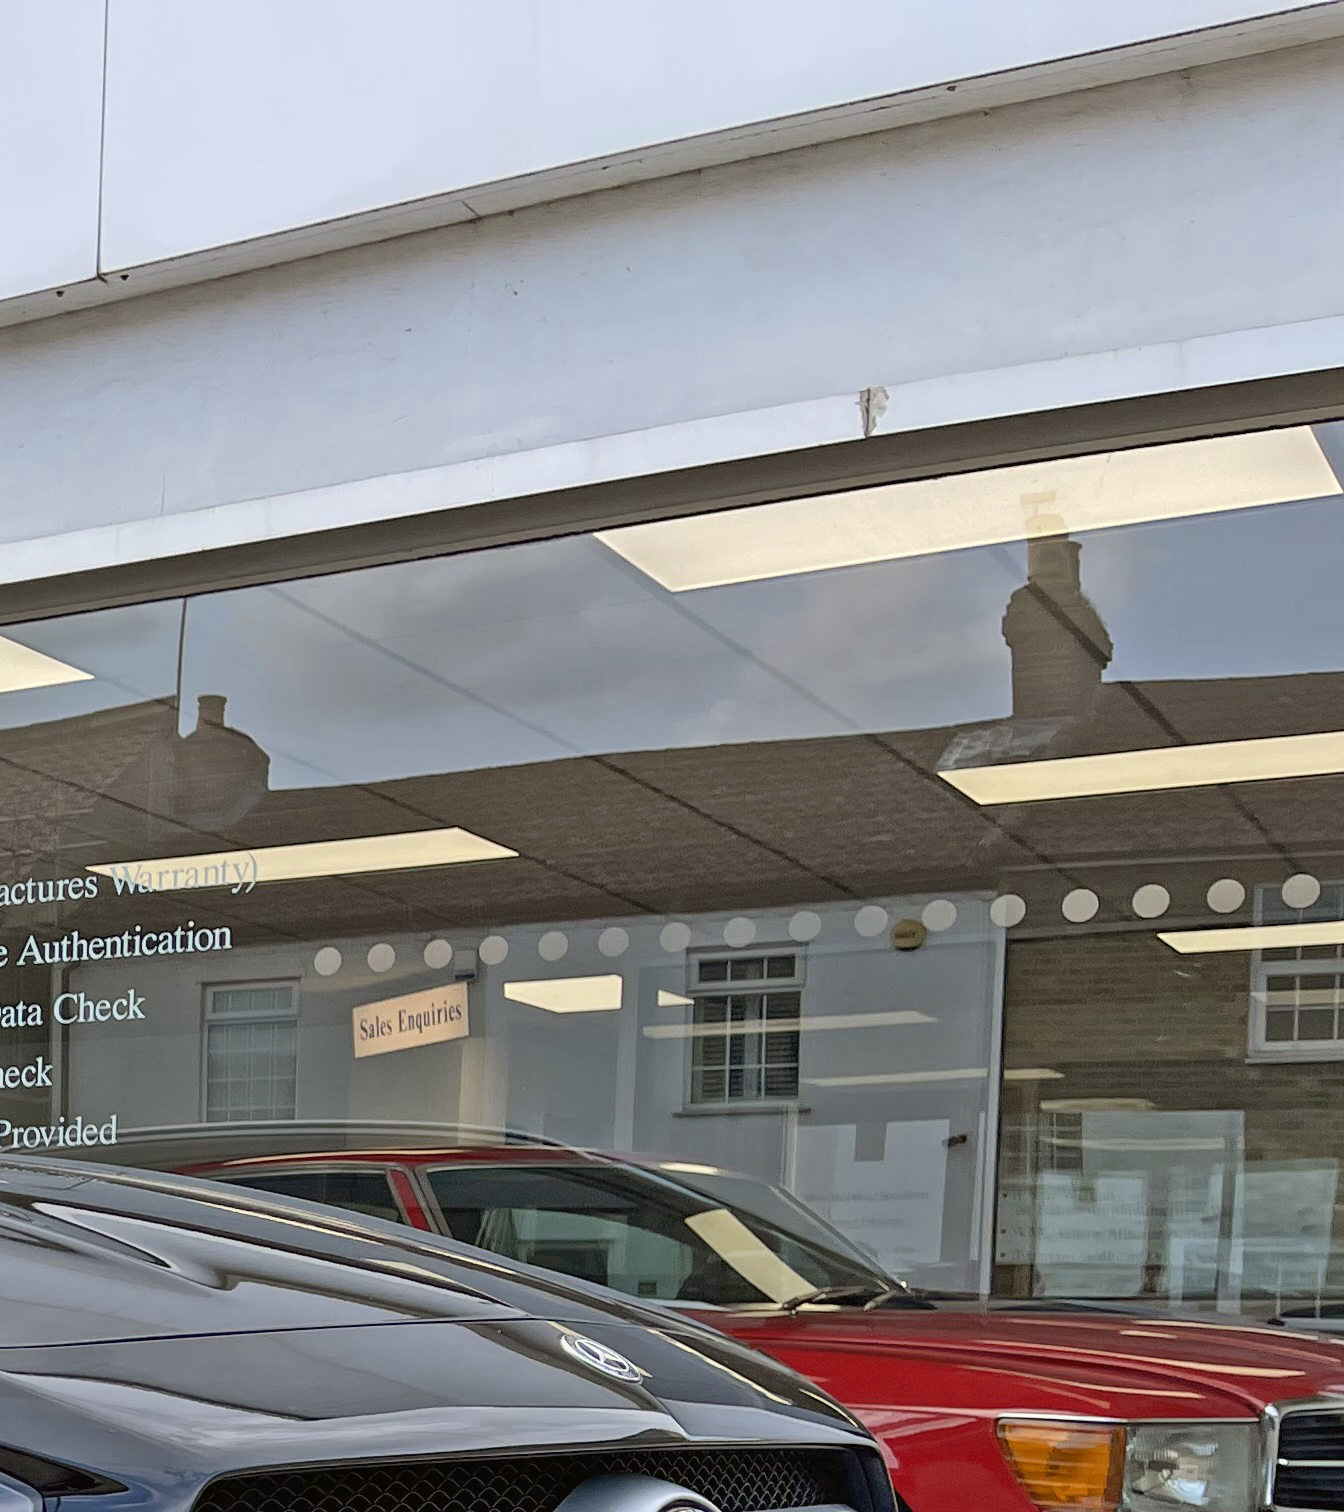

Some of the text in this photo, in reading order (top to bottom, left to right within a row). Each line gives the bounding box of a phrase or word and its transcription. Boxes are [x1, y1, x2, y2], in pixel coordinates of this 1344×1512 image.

[109, 851, 258, 895] Warranty)
[16, 920, 233, 966] Authentication
[52, 989, 146, 1025] Check
[359, 1000, 462, 1041] Sales Enquiries
